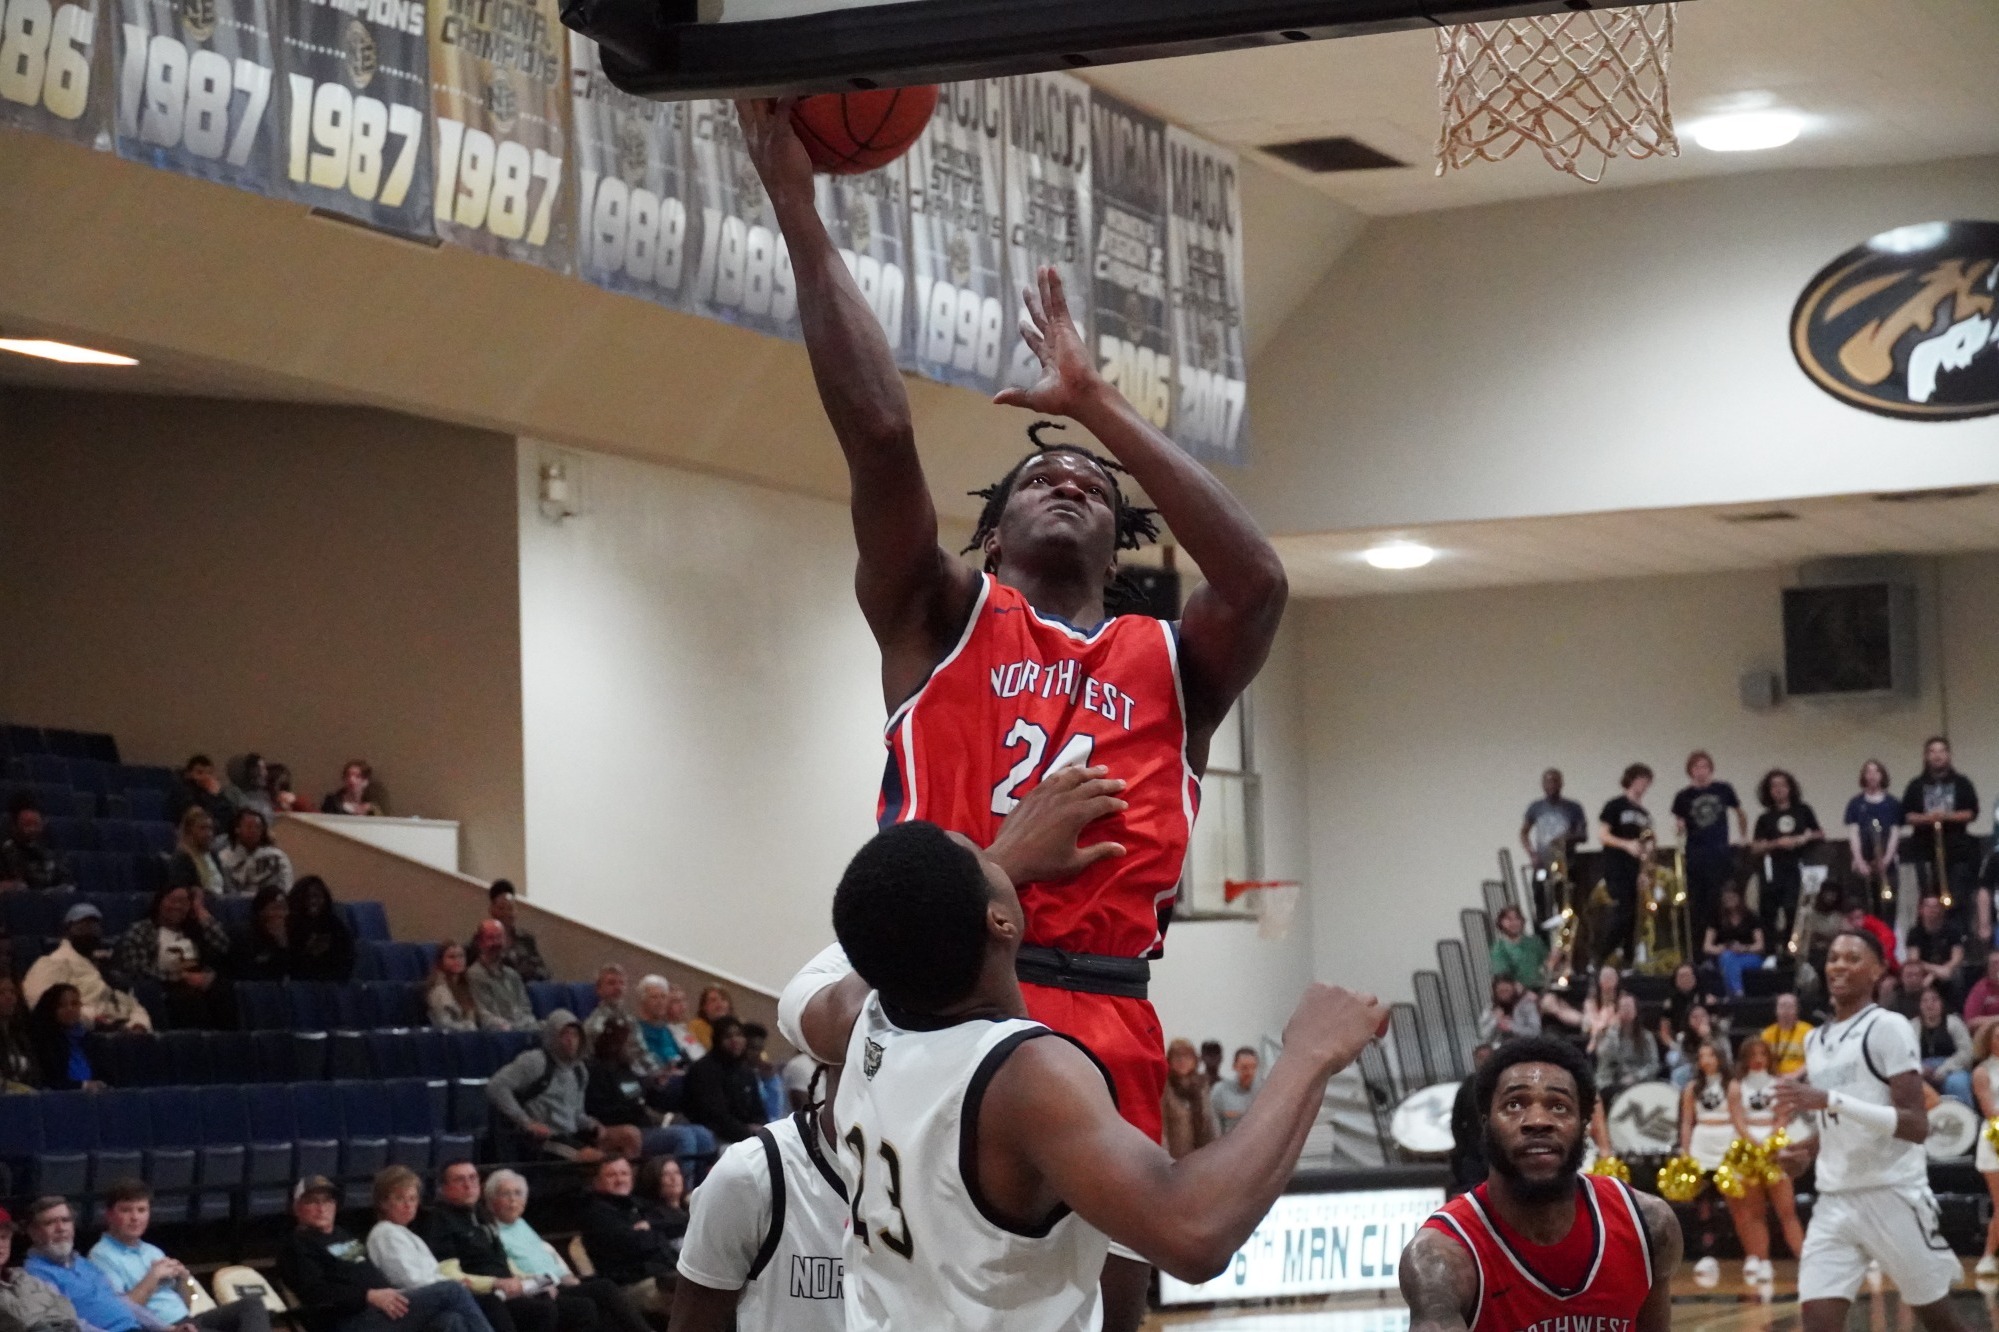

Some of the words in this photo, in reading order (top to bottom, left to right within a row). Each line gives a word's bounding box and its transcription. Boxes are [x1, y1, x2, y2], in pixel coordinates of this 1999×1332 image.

[119, 23, 271, 166] 1987
[288, 72, 422, 207] 1987
[434, 117, 562, 246] 1987
[579, 169, 686, 290] 1988
[700, 207, 798, 322] 1989
[844, 1122, 914, 1263] 23
[1282, 1226, 1351, 1284] MAN
